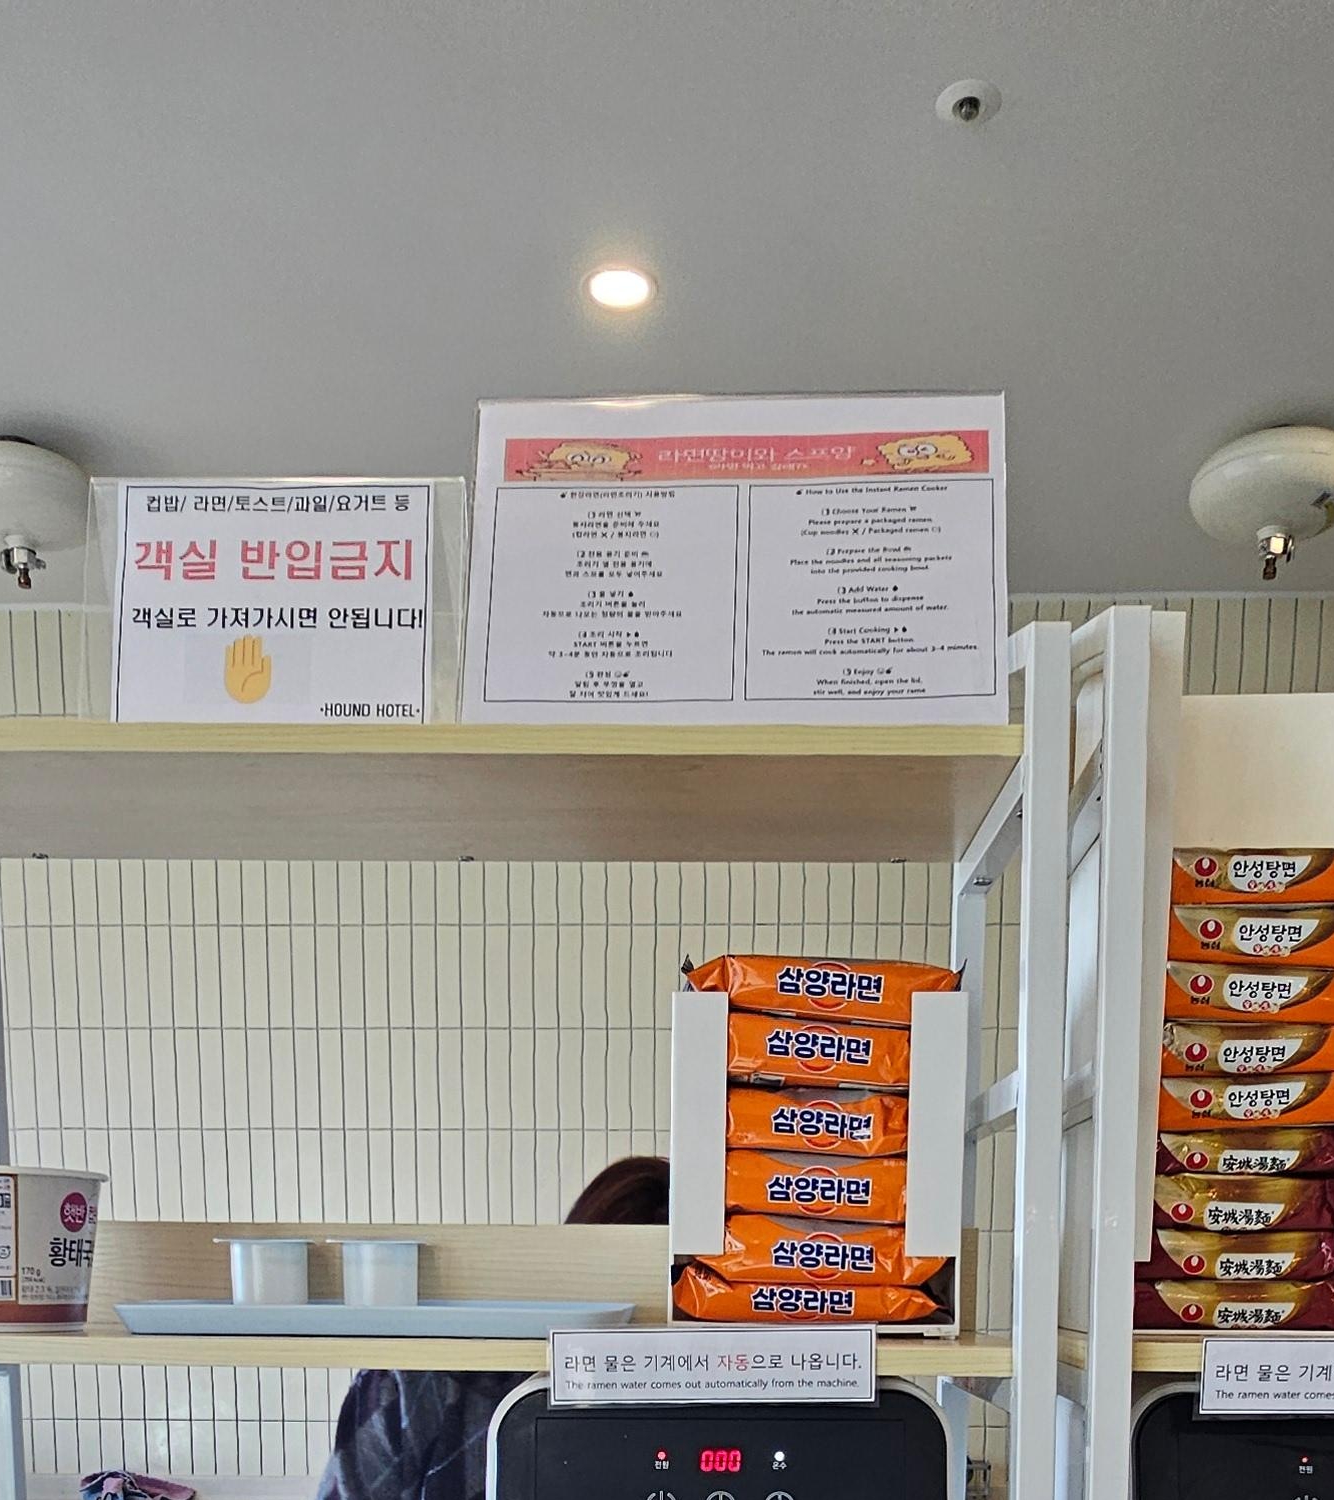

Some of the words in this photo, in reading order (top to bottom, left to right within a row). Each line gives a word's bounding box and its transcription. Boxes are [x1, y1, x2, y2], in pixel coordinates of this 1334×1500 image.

[145, 495, 186, 513] 컵밥/
[193, 495, 386, 514] 라면/토스트/과일/요거트
[394, 495, 410, 512] 등
[134, 539, 217, 580] 객실
[240, 539, 412, 580] 반입금지
[132, 607, 197, 628] 객실로
[207, 607, 317, 629] 가져가시면
[328, 607, 424, 629] 안됩니다!
[1233, 859, 1296, 879] 안성탕면
[1238, 923, 1302, 943] 안성탕면
[777, 966, 883, 1003] 삼양라면
[1228, 979, 1292, 999] 안성탕면
[767, 1029, 873, 1065] 삼양라면
[1222, 1045, 1286, 1063] 안성탕면
[1228, 1088, 1291, 1107] 안성탕면
[771, 1107, 874, 1140] 삼양라면
[767, 1174, 872, 1207] 삼양라면
[63, 1202, 86, 1223] 햇반
[771, 1240, 875, 1273] 삼양라면
[750, 1286, 855, 1315] 삼양라면
[565, 1356, 597, 1373] 라면
[604, 1355, 637, 1373] 물은
[644, 1355, 710, 1372] 기계에서
[717, 1354, 784, 1372] 자동으로
[791, 1353, 863, 1372] 나옵니다.
[566, 1380, 583, 1390] The
[587, 1381, 617, 1390] ramen
[620, 1380, 648, 1390] water
[651, 1380, 682, 1389] comes
[685, 1380, 702, 1389] out
[705, 1378, 769, 1391] automatically
[771, 1377, 795, 1389] from
[797, 1378, 815, 1388] the
[817, 1378, 859, 1389] machine.
[1216, 1365, 1249, 1383] 라면
[1257, 1365, 1291, 1383] 물은
[1215, 1390, 1234, 1400] The
[1237, 1391, 1270, 1400] ramen
[1273, 1390, 1301, 1400] water
[700, 1449, 741, 1472] 000
